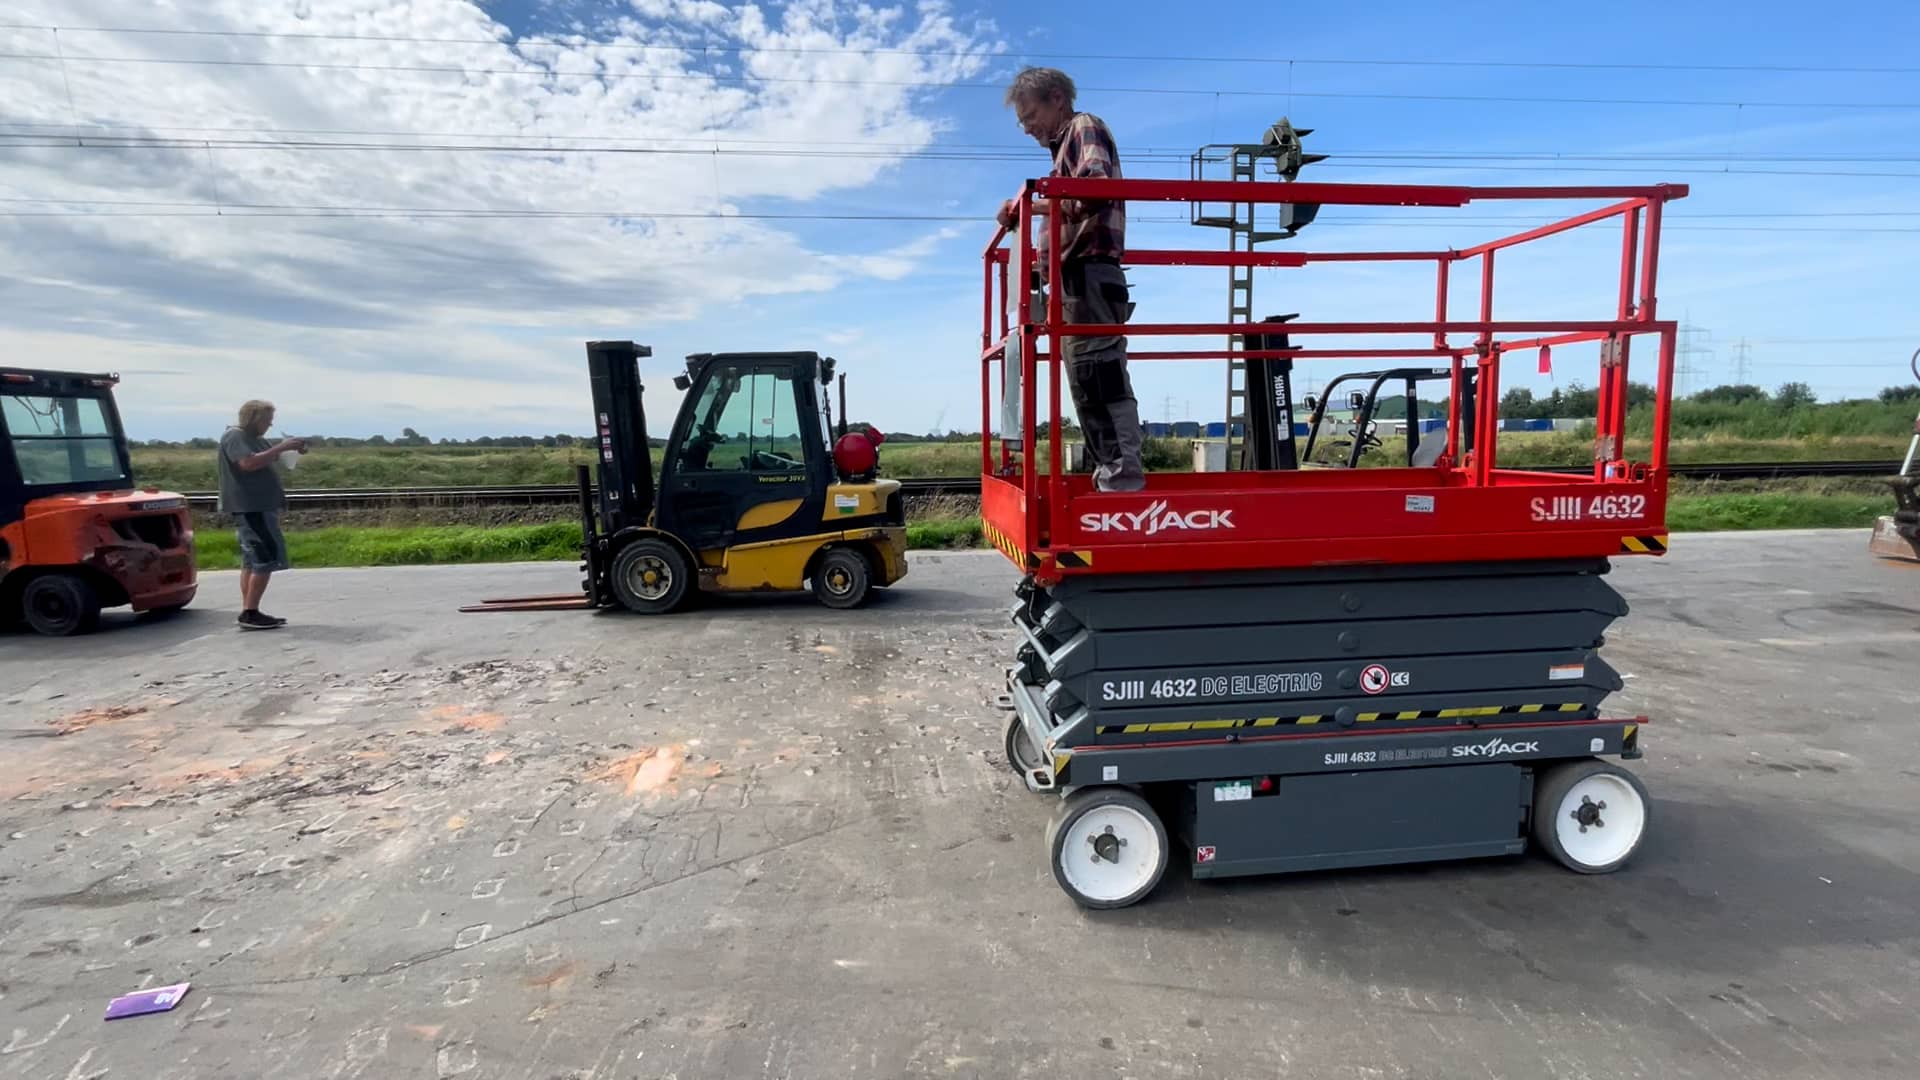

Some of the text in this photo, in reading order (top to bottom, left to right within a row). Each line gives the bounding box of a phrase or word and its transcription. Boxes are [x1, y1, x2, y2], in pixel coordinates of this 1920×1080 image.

[1274, 375, 1286, 407] CLARK
[1080, 499, 1235, 536] SKYJACK
[1530, 494, 1645, 521] SJIII 4632
[1102, 672, 1322, 701] SJIII 4632 DC ELECTRIC
[1324, 753, 1347, 765] SJIII
[1350, 751, 1376, 763] 4632
[1451, 737, 1539, 757] SKYJACK
